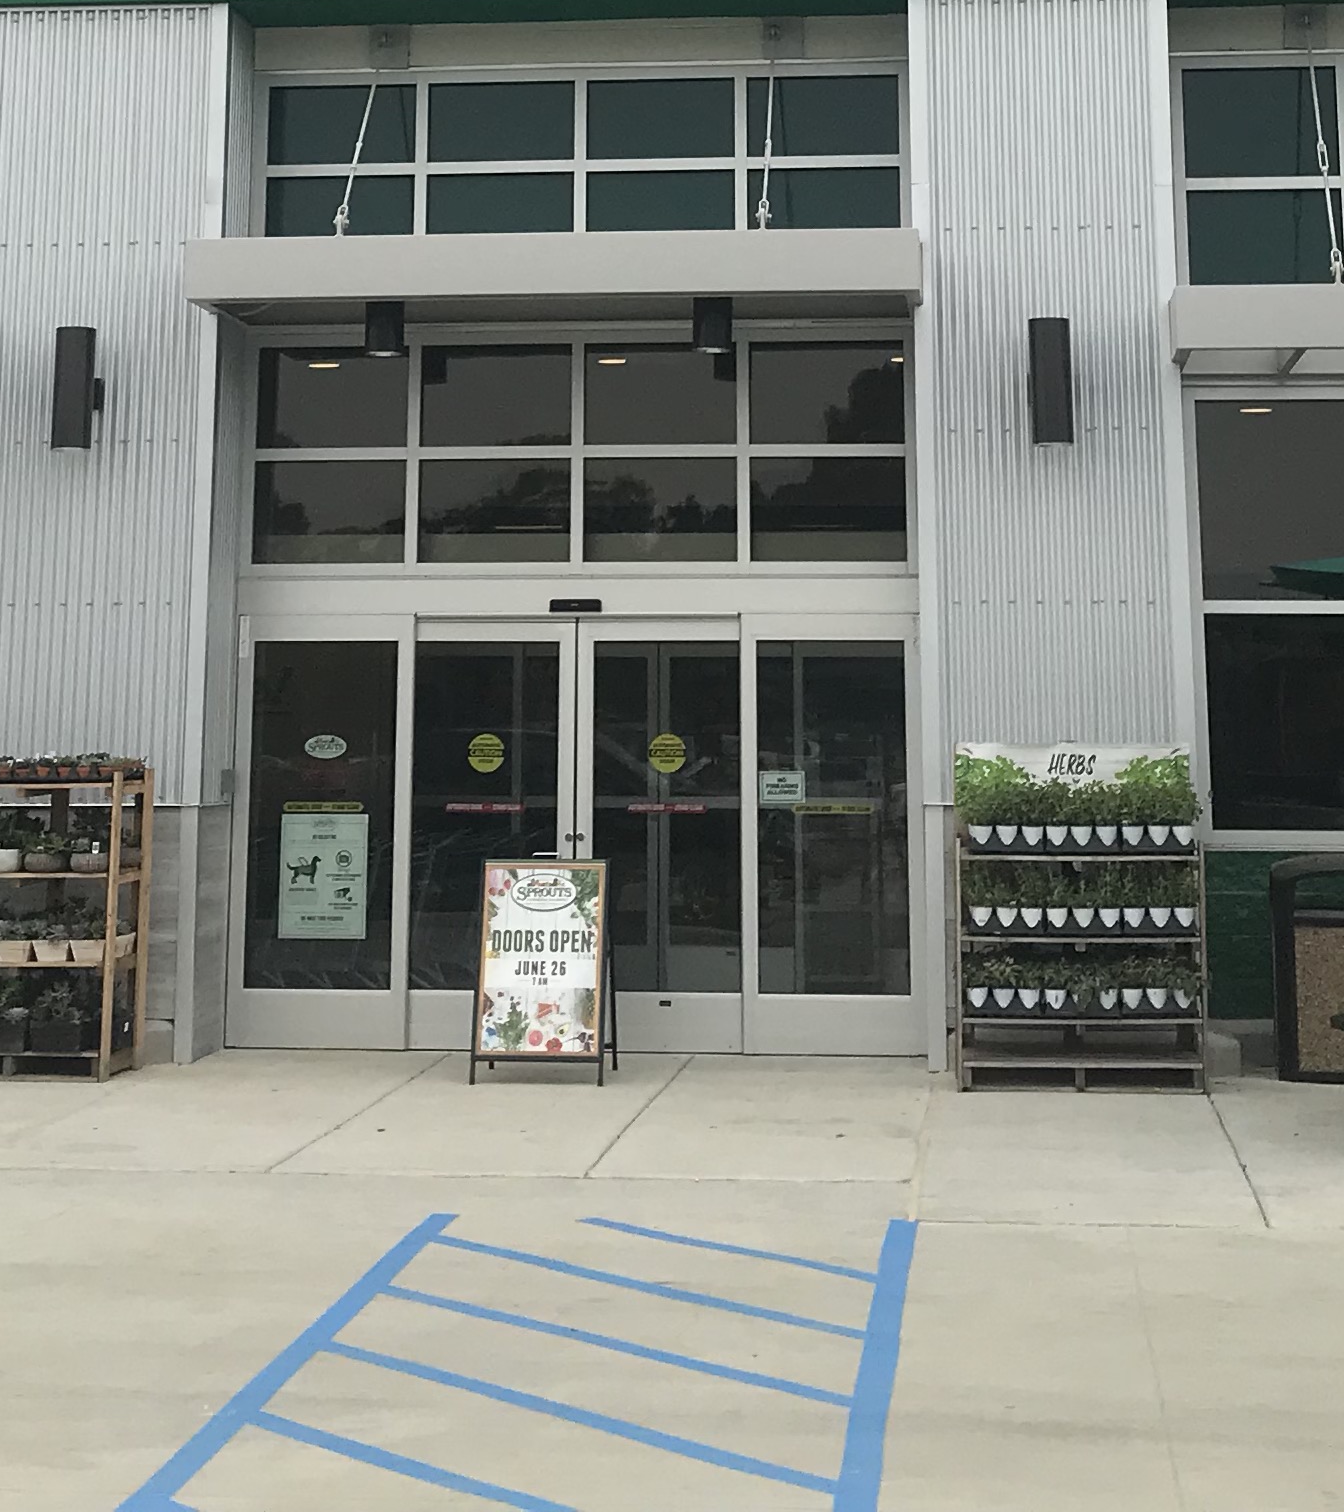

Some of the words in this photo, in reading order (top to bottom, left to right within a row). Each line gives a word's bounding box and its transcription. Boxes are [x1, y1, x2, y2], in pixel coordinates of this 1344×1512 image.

[1047, 752, 1097, 776] HERBS
[516, 887, 572, 901] SPROUTS
[492, 929, 545, 953] DOORS
[549, 929, 592, 953] OPEN
[515, 960, 546, 976] JUNE
[551, 960, 567, 976] 26
[532, 977, 537, 986] 7
[538, 977, 548, 986] AM
